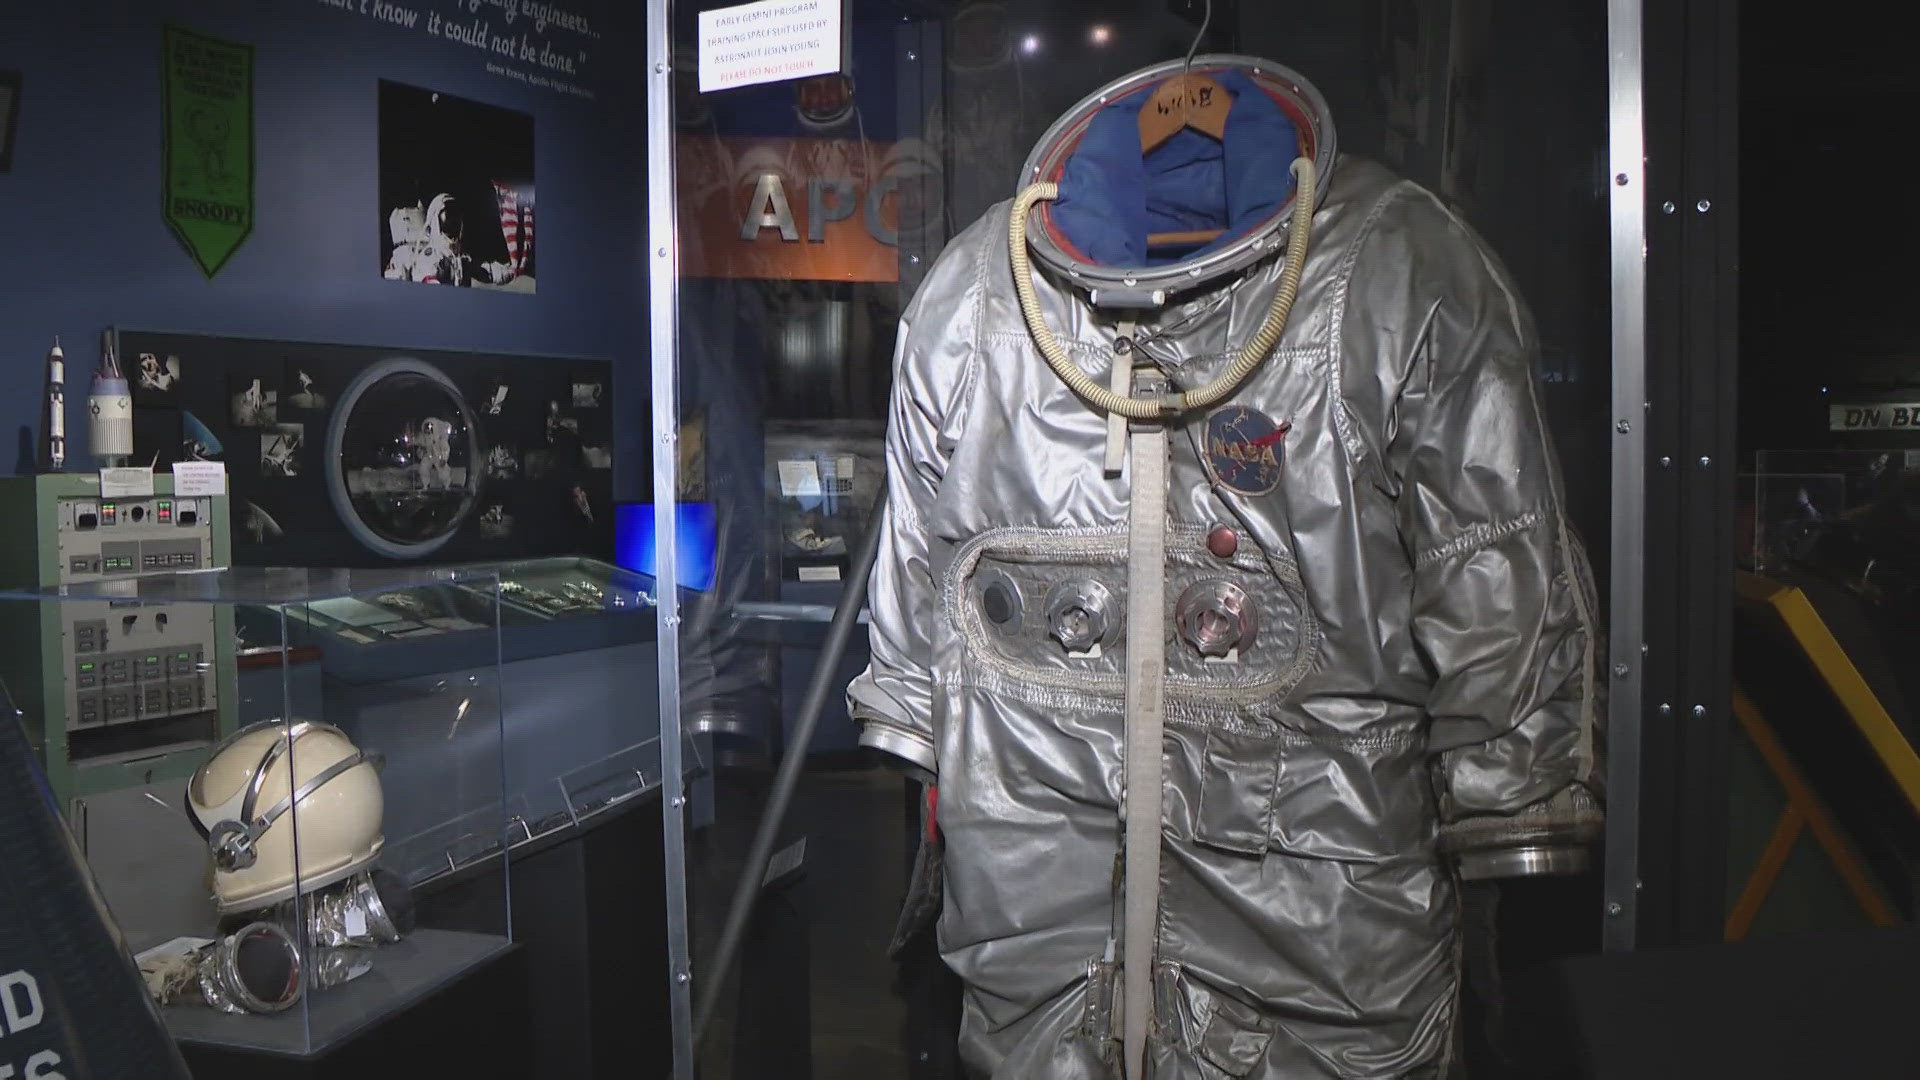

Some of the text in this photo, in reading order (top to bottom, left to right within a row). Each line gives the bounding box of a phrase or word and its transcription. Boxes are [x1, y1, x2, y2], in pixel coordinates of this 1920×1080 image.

[716, 1, 818, 28] EARLY GEMINI PROGRAM
[373, 0, 418, 28] know
[427, 10, 441, 36] it
[444, 18, 489, 49] could
[491, 34, 516, 59] not
[519, 33, 537, 63] be
[706, 33, 746, 48] TRAINING
[792, 22, 814, 34] USED
[816, 20, 828, 29] BY
[714, 39, 820, 64] ASTRONAUT JOHN YOUNG
[748, 68, 762, 78] DO
[764, 65, 782, 76] NOT
[785, 60, 814, 72] TOUCH
[174, 198, 246, 226] SNOOPY
[1844, 408, 1881, 427] ON
[1212, 436, 1278, 465] NASA
